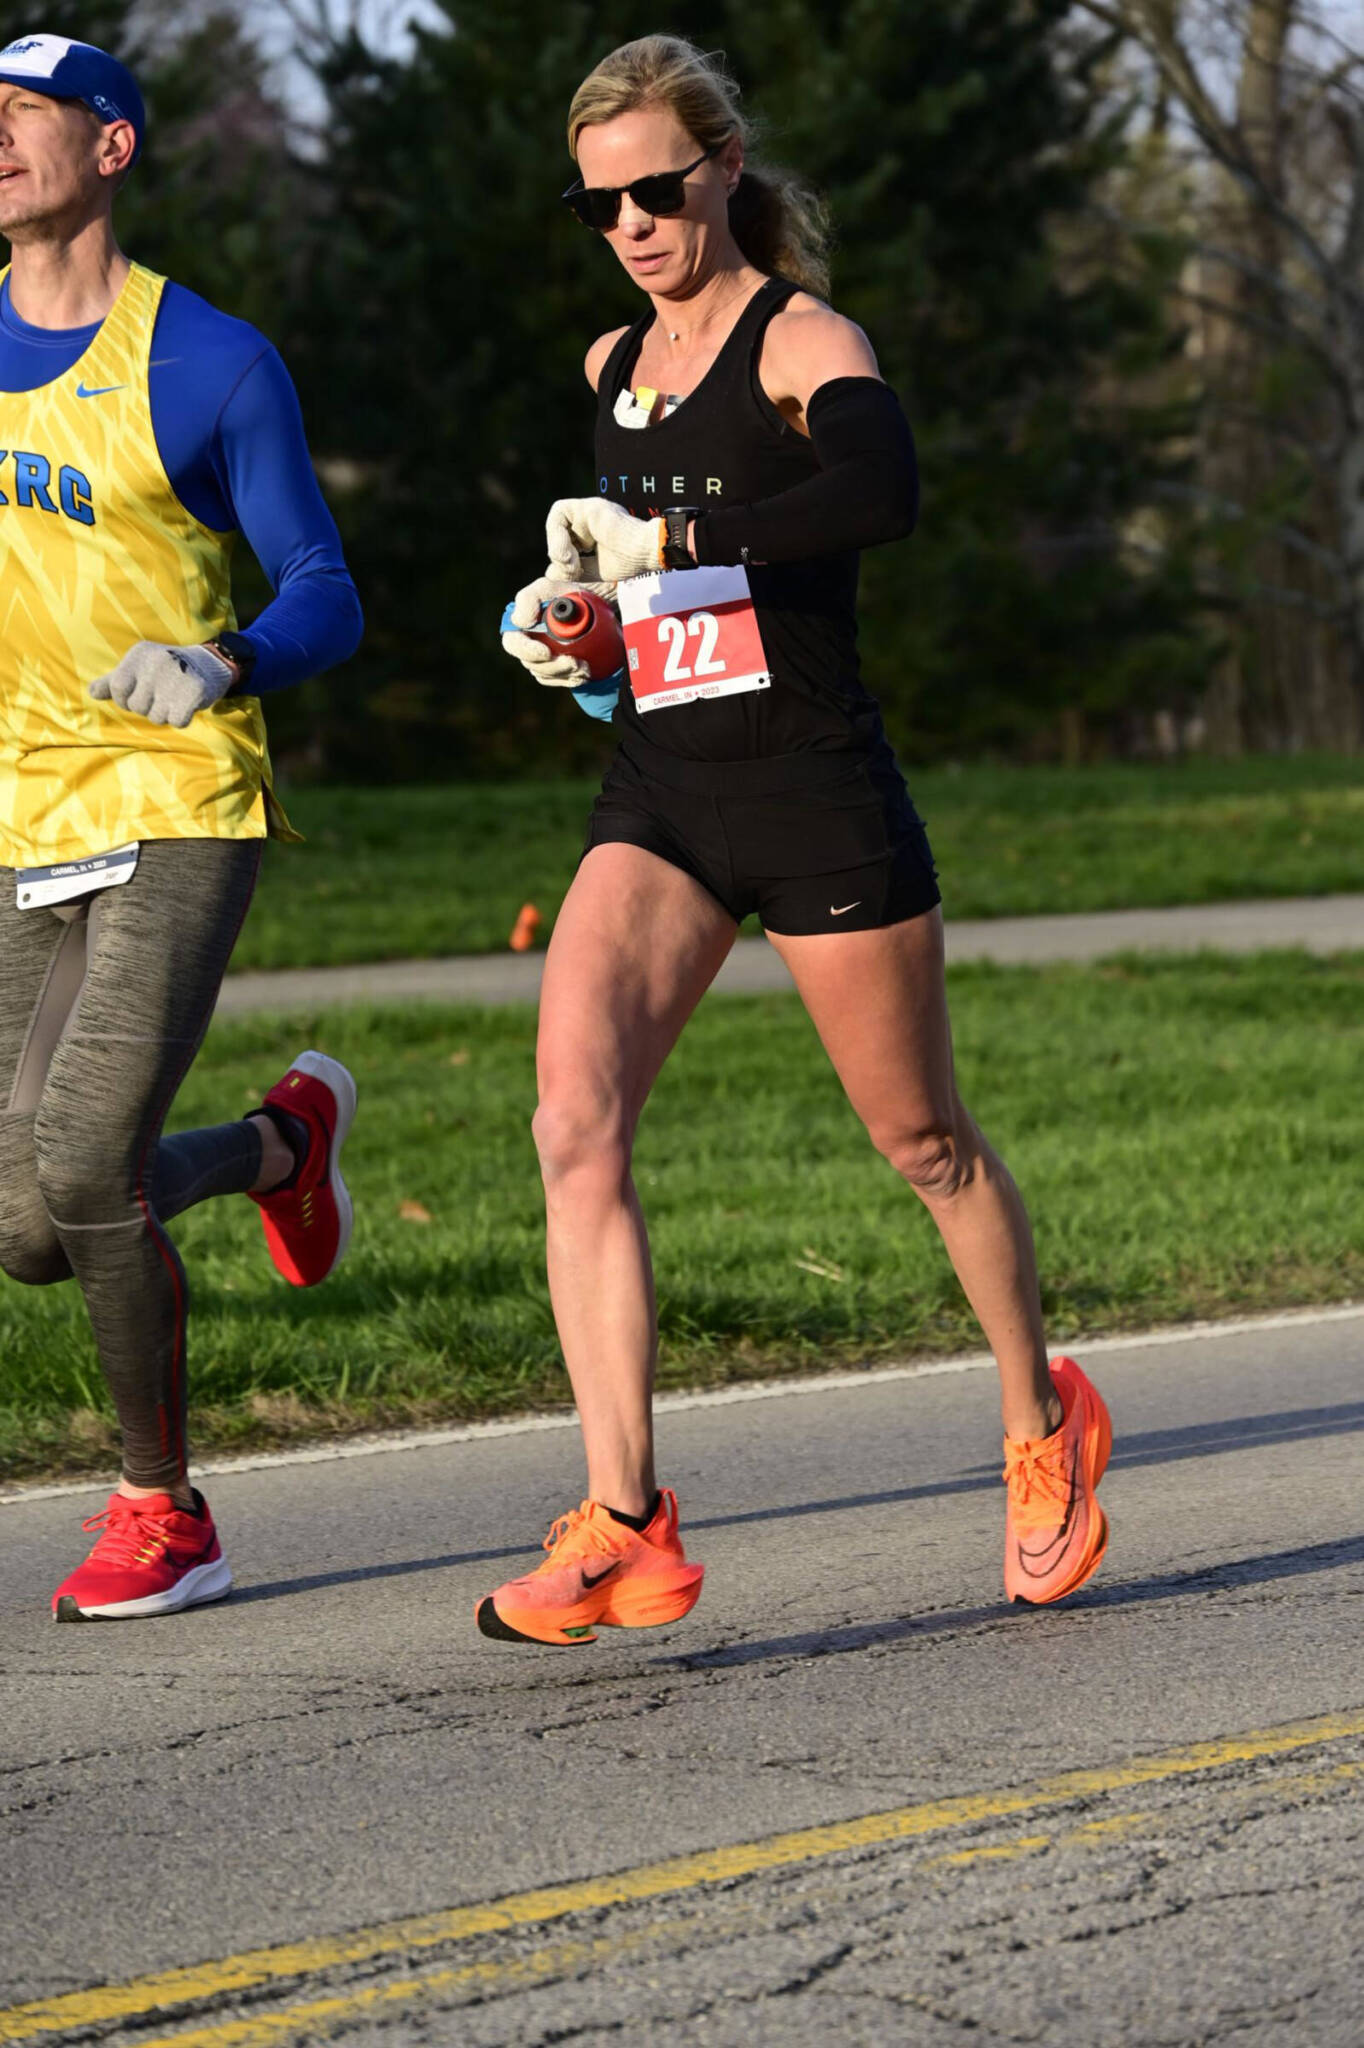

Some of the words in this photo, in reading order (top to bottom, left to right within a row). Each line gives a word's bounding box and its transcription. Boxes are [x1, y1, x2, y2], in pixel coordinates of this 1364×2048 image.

[0, 449, 96, 526] RC
[600, 475, 722, 495] OTHER
[657, 611, 727, 682] 22
